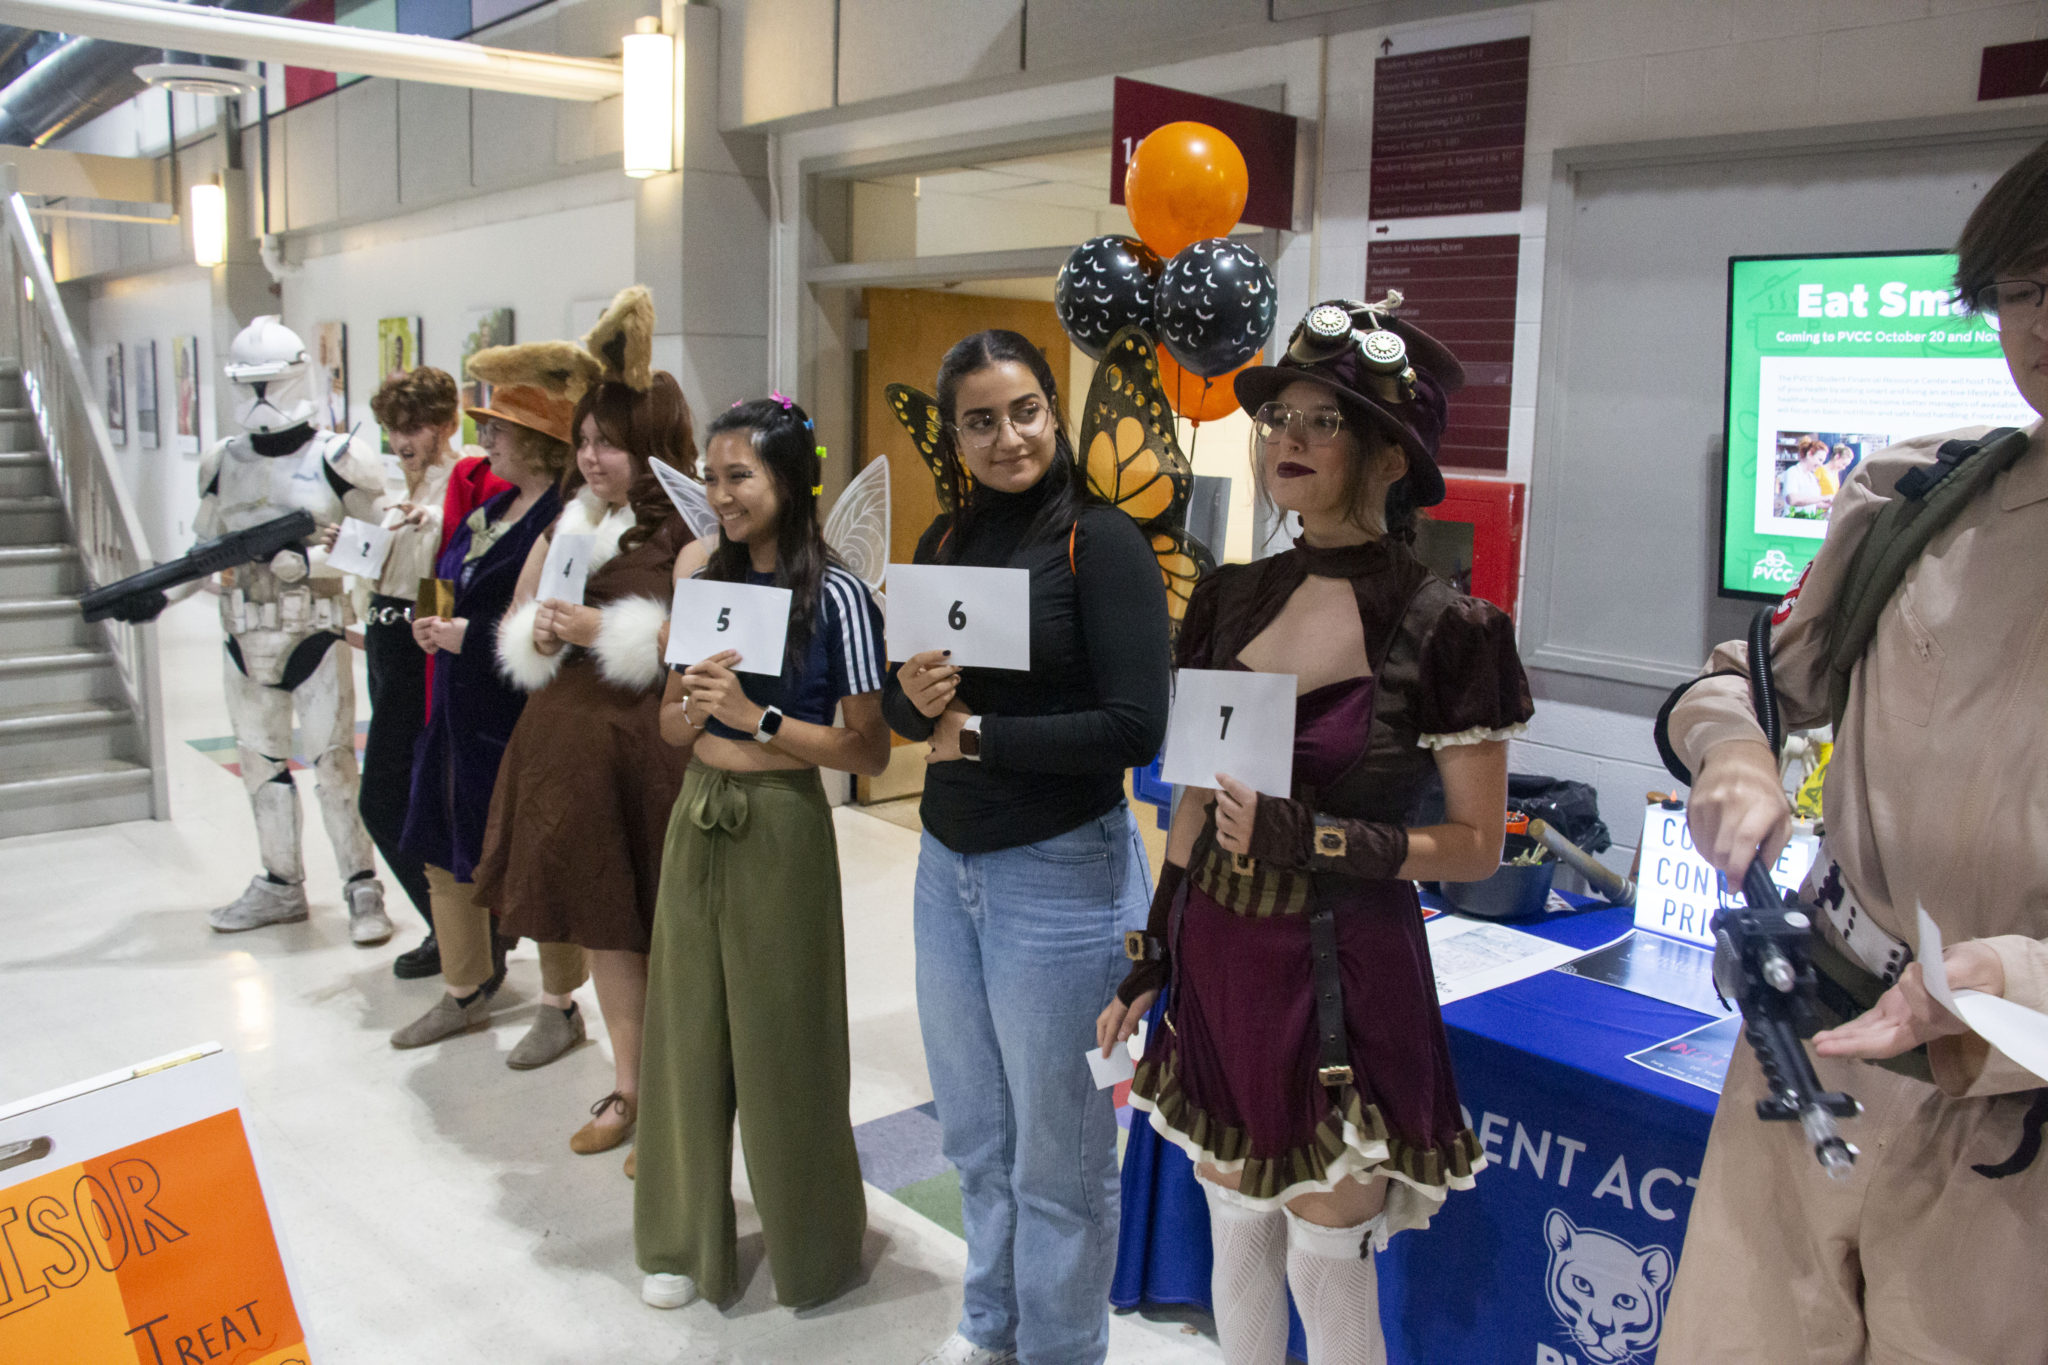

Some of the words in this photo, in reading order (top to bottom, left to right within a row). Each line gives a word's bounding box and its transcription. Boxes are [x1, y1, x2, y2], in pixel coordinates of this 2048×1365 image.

[1797, 283, 1870, 319] Eat
[1775, 331, 1821, 345] Coming
[1822, 331, 1835, 343] to
[1837, 331, 1873, 343] PVCC
[1874, 331, 1927, 343] October
[1928, 331, 1946, 343] 20
[1947, 330, 1973, 343] and
[1974, 330, 2000, 343] Nov
[361, 541, 370, 558] 2
[562, 557, 574, 578] 4
[1752, 565, 1794, 583] PVCC
[716, 607, 731, 632] 5
[947, 600, 967, 631] 6
[1219, 705, 1235, 741] 7
[124, 1300, 263, 1365] TREAT
